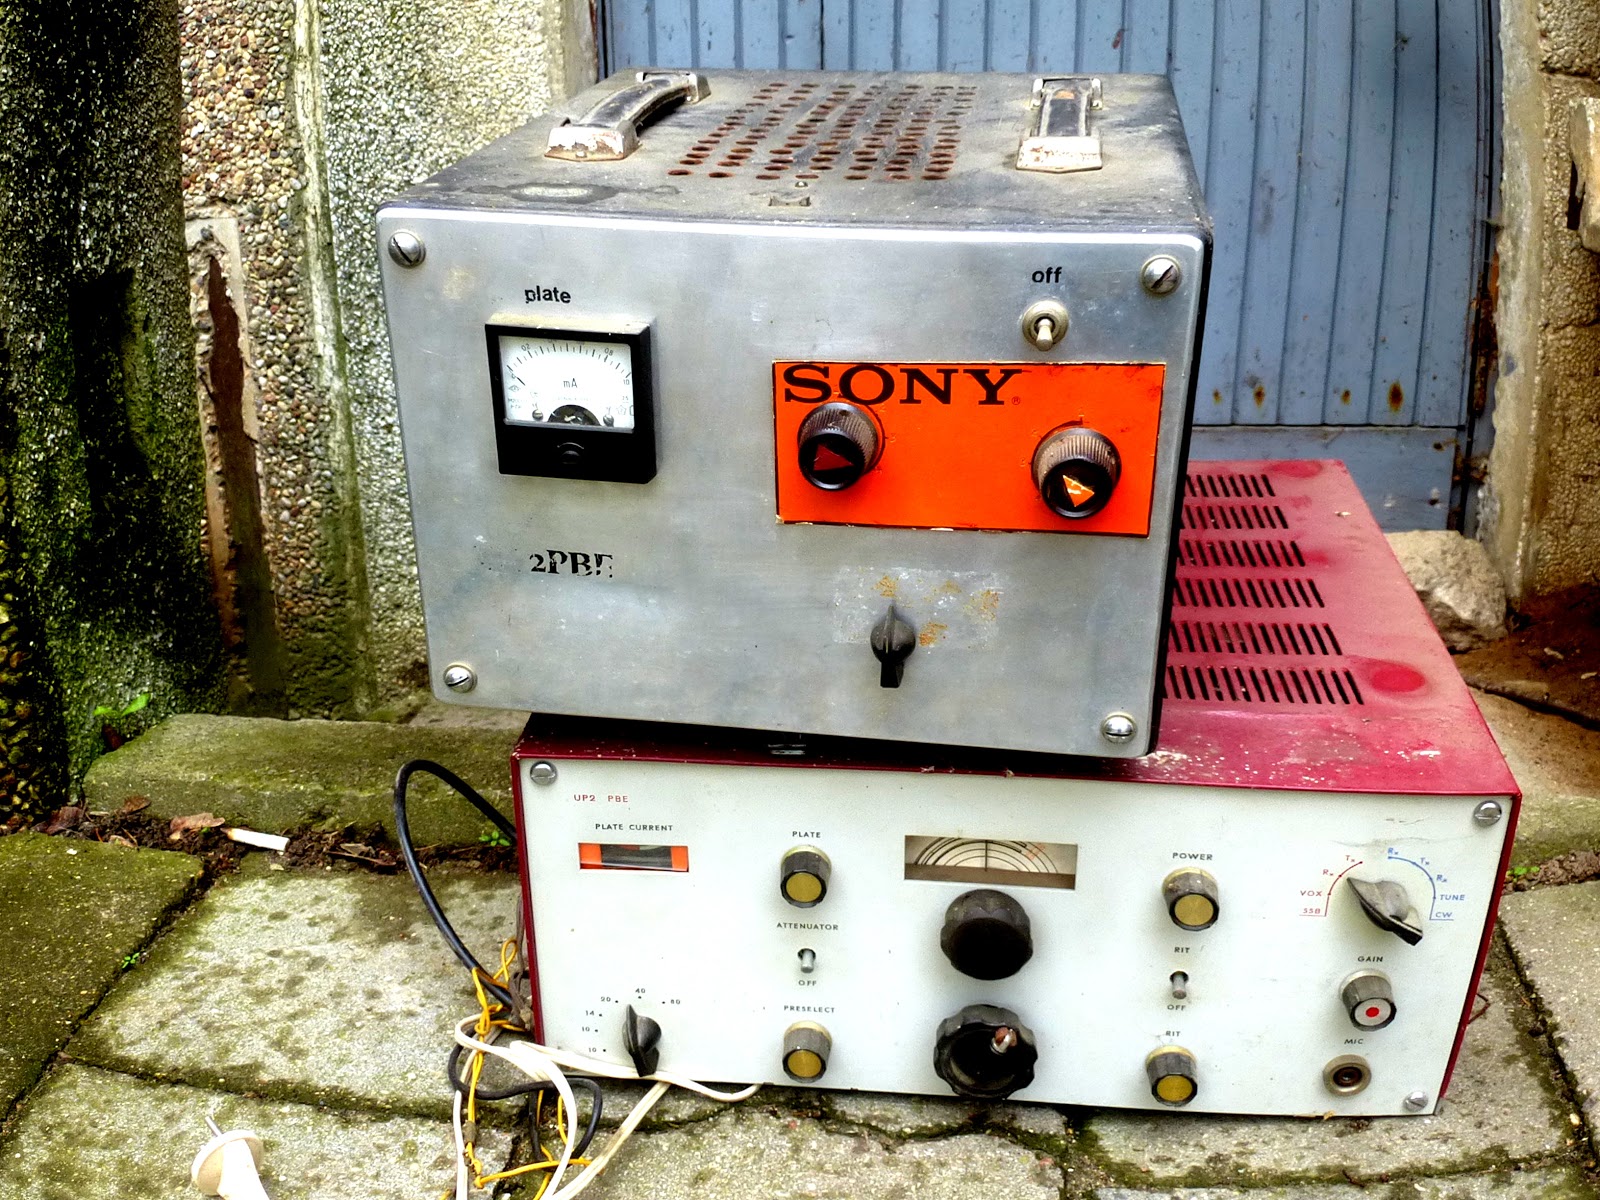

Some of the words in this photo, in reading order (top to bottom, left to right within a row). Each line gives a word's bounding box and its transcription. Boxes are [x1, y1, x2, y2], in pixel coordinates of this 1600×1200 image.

[1031, 266, 1063, 284] off
[524, 284, 572, 304] plate
[562, 377, 578, 388] mA
[782, 364, 1023, 405] SONY
[573, 794, 596, 802] UP2
[607, 794, 629, 803] PBE
[595, 823, 624, 831] PLATE
[628, 824, 673, 832] CURRENT
[791, 830, 821, 839] PLATE
[1172, 852, 1213, 861] POWER
[1435, 911, 1453, 919] CW
[776, 922, 839, 931] ATTENUATOR
[1173, 946, 1191, 954] RIT
[1357, 955, 1384, 963] GAIN
[797, 979, 817, 987] OFF
[783, 1005, 835, 1014] PRESELECT
[1166, 1004, 1187, 1012] OFF
